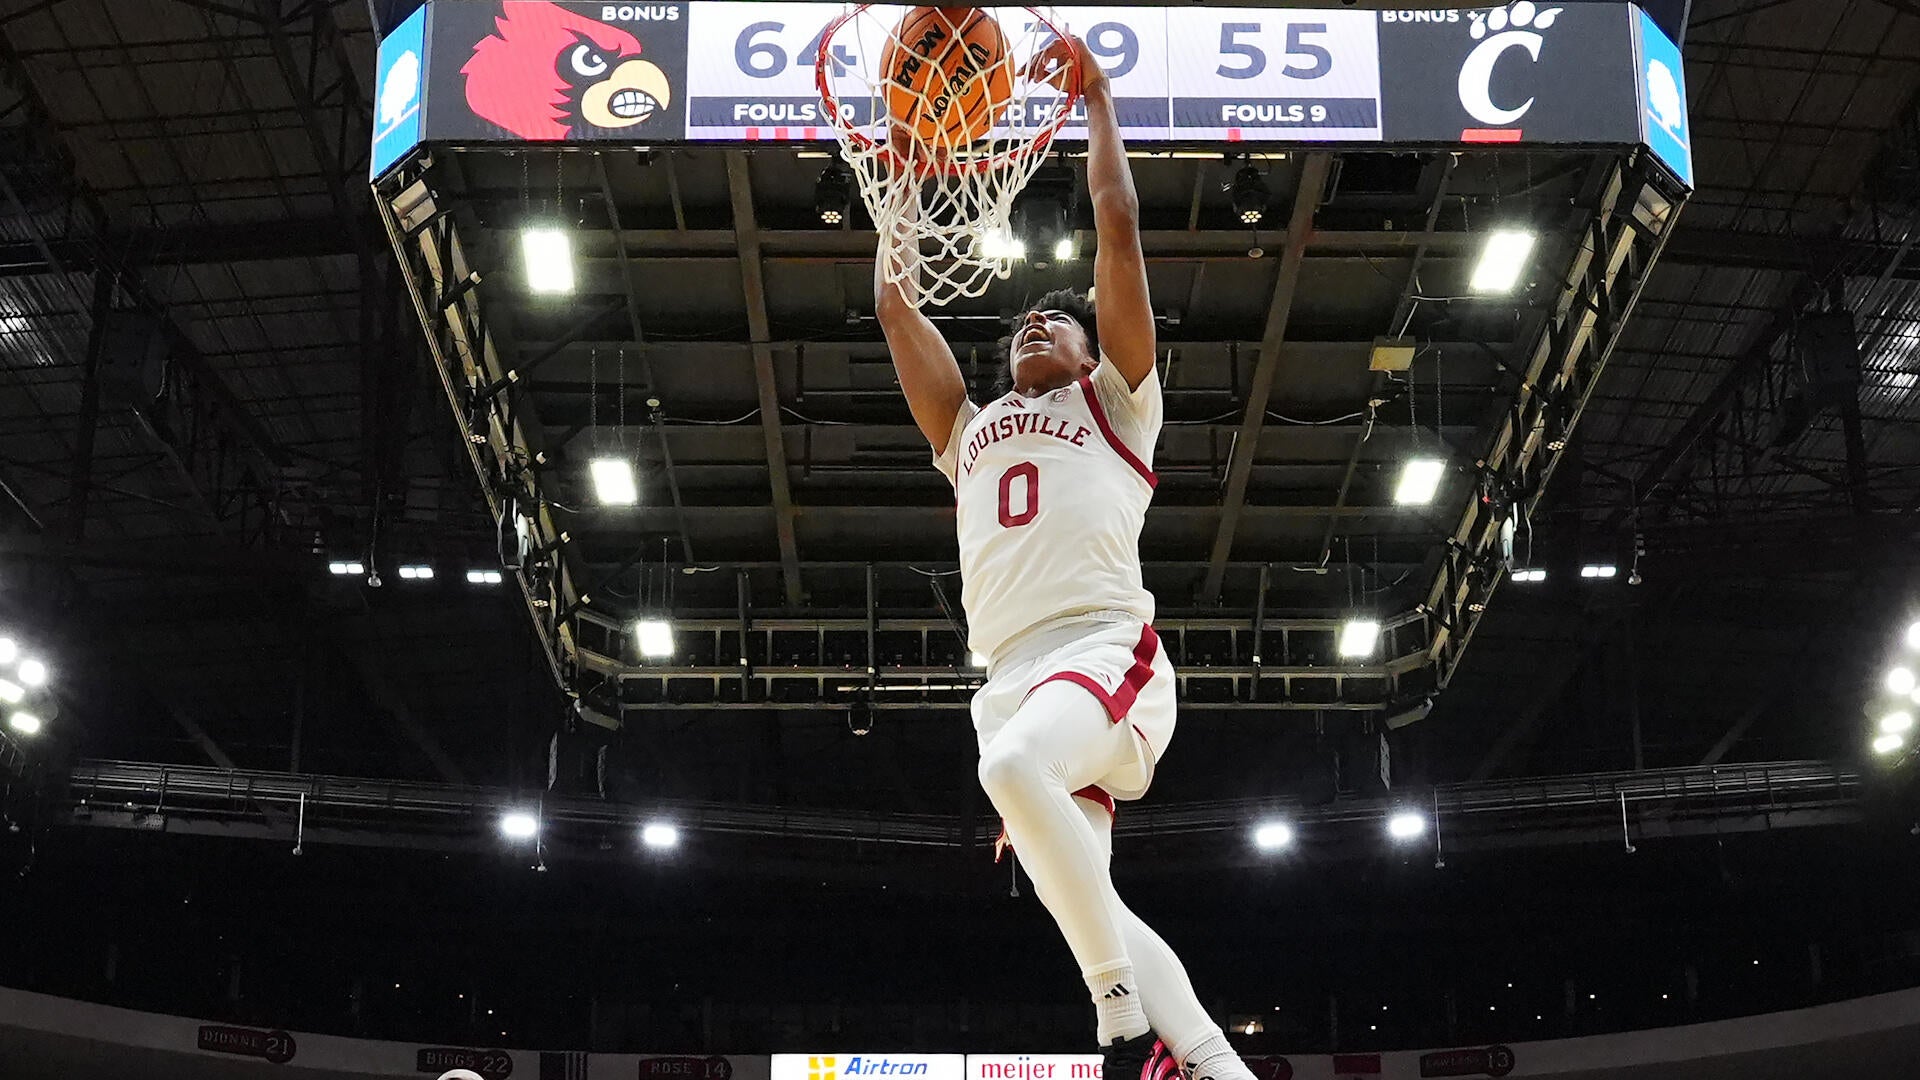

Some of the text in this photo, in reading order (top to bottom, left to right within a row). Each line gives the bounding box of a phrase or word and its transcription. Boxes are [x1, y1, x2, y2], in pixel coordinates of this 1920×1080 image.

[601, 5, 680, 21] BONUS
[1382, 9, 1460, 23] BONUS
[734, 20, 857, 79] 64
[896, 23, 947, 88] NCAA
[1215, 22, 1333, 80] 55
[733, 103, 817, 121] FOULS
[1221, 104, 1328, 122] FOULS 9
[963, 412, 1092, 476] LOUISVILLE
[998, 461, 1039, 529] 0
[265, 1037, 289, 1056] 21
[482, 1055, 509, 1074] 22
[650, 1061, 727, 1079] ROSE 14
[844, 1057, 928, 1075] Airtron
[981, 1056, 1056, 1080] meijer
[1487, 1051, 1511, 1070] 13
